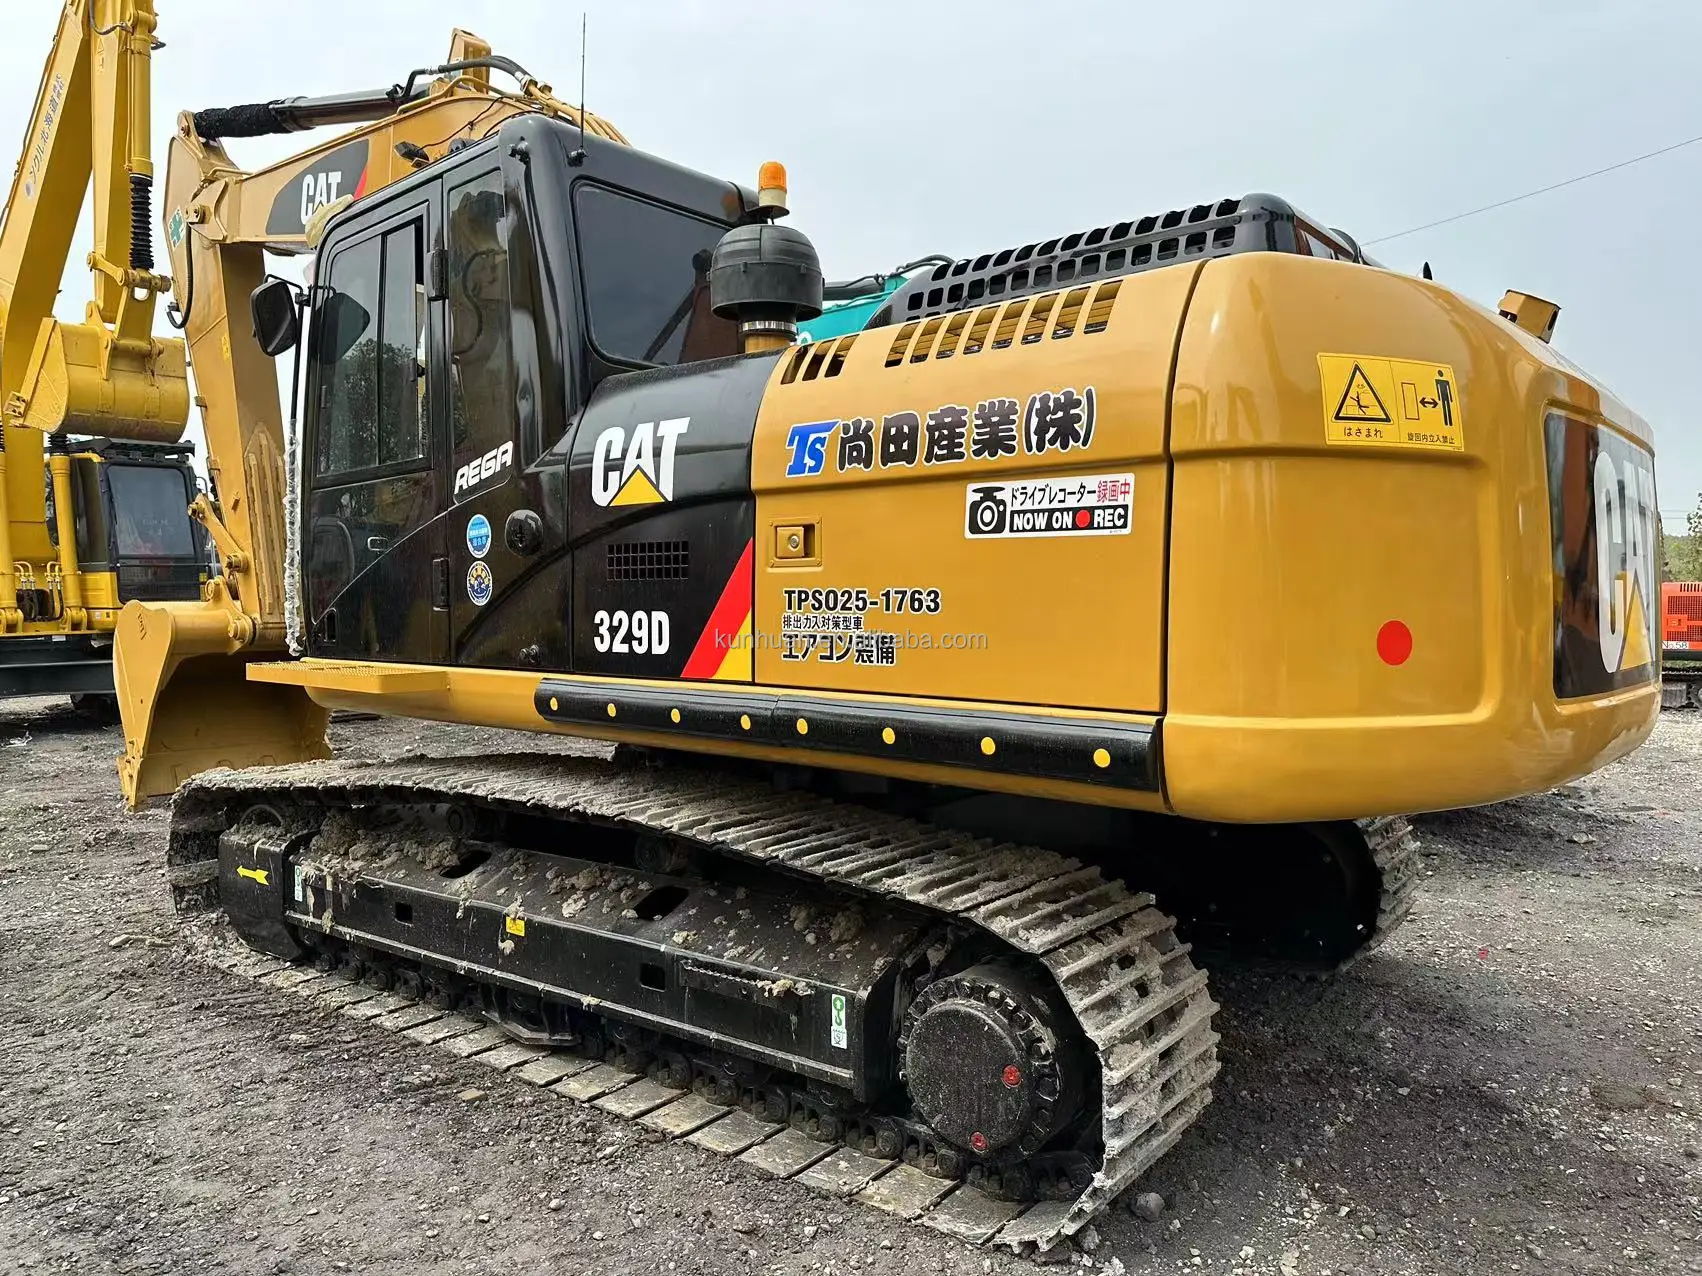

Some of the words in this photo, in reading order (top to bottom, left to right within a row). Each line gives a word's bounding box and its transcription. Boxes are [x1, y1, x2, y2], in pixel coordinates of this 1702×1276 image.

[300, 171, 342, 225] CAT
[1343, 425, 1383, 439] はさまれ
[454, 441, 513, 494] REGA
[591, 417, 691, 507] CAT
[1013, 511, 1048, 531] NOW
[1052, 510, 1073, 529] ON
[1093, 507, 1125, 528] REC
[1593, 451, 1657, 673] CAT
[593, 609, 670, 656] 329D
